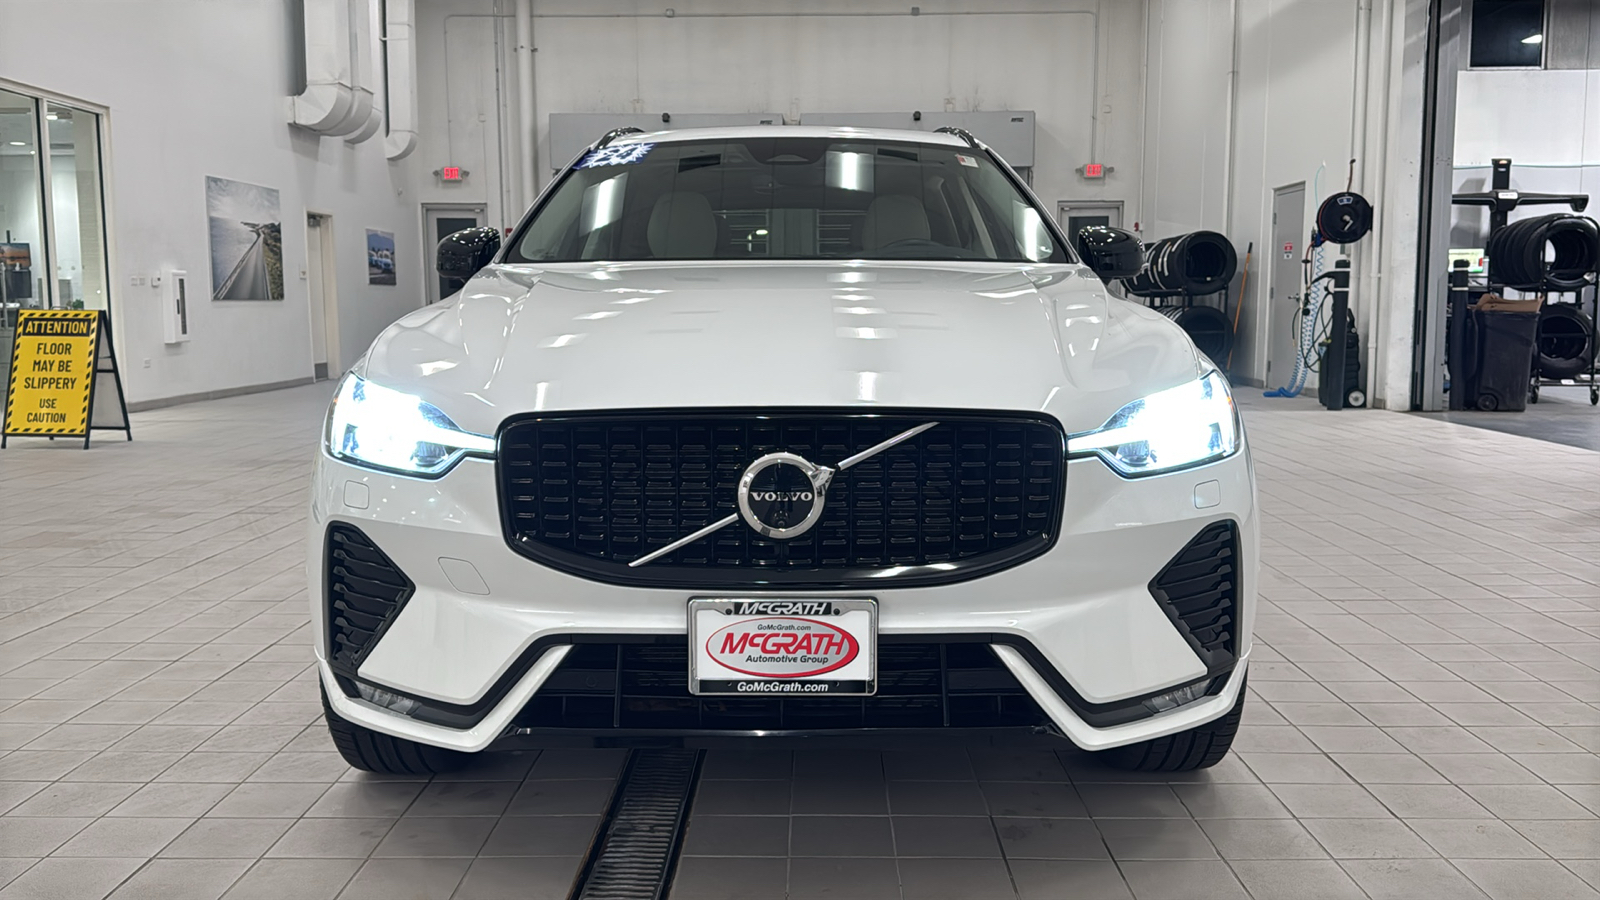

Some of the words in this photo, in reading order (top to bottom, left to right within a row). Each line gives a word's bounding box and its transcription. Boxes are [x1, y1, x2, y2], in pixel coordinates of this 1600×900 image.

[25, 321, 88, 333] ATTENTION
[36, 342, 72, 355] FLOOR
[32, 360, 55, 372] MAY
[58, 360, 72, 372] BE
[24, 377, 77, 389] SLIPPERY
[39, 398, 57, 409] USE
[26, 412, 66, 423] CAUTION
[750, 491, 812, 501] VOLVO
[757, 623, 812, 631] GoMcGrath.com
[745, 655, 798, 663] Automotive
[800, 655, 829, 664] Group
[737, 681, 828, 692] GoMcGrath.com
